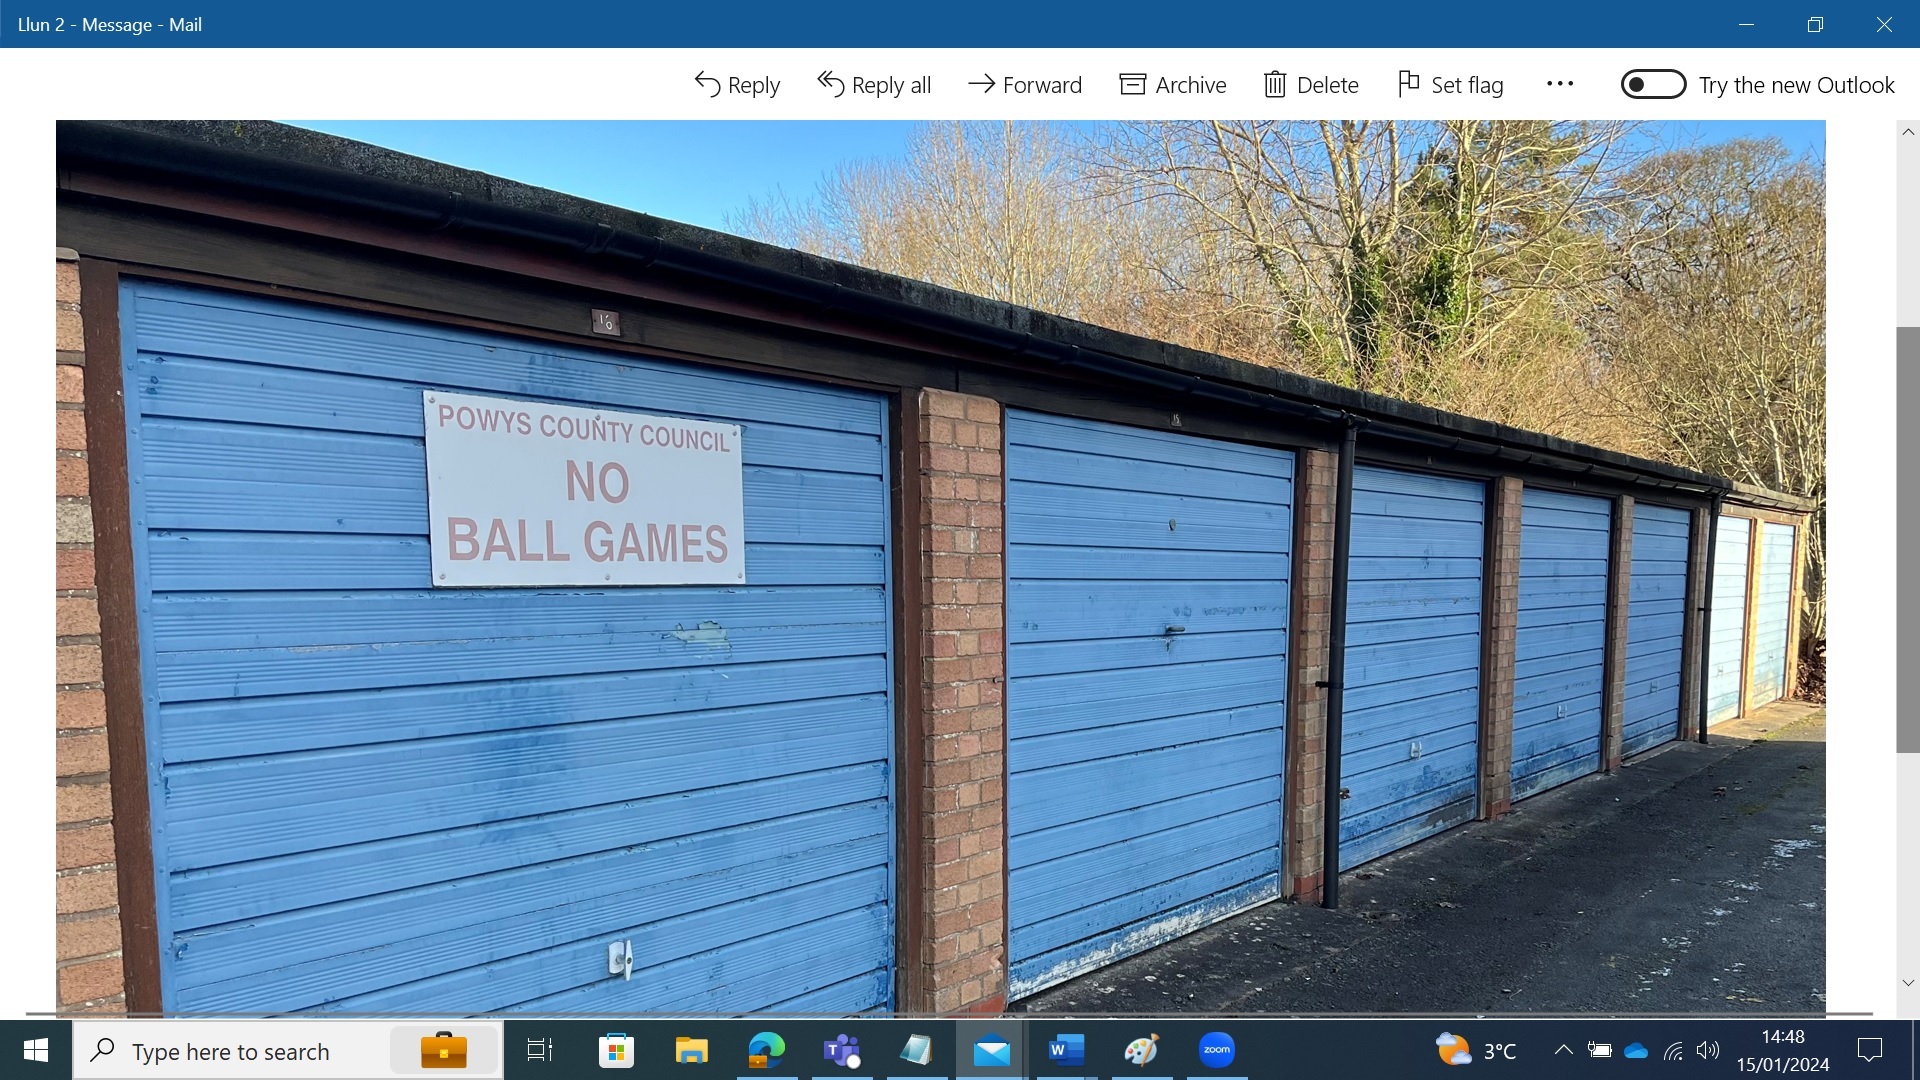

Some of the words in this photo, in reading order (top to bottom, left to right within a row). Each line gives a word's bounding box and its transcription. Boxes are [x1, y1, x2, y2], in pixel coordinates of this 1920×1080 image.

[18, 16, 50, 32] Llun
[55, 17, 65, 32] 2
[82, 17, 153, 36] Message
[169, 16, 202, 32] Mail
[729, 75, 782, 99] Reply
[853, 75, 906, 99] Reply
[910, 75, 931, 94] all
[1004, 75, 1082, 94] Forward
[1155, 75, 1227, 94] Archive
[1298, 75, 1360, 94] Delete
[1432, 76, 1463, 94] Set
[1467, 75, 1504, 99] flag
[1698, 76, 1729, 99] Try
[1733, 75, 1766, 94] the
[1772, 80, 1812, 94] new
[1817, 75, 1896, 94] Outlook
[438, 404, 532, 435] POWYS
[539, 414, 634, 443] COUNTY
[639, 424, 731, 453] COUNCIL
[566, 459, 629, 504] NO
[447, 517, 570, 562] BALL
[584, 520, 728, 563] GAMES
[1761, 1029, 1806, 1044] 14:48
[131, 1043, 180, 1066] Type
[187, 1042, 231, 1061] here
[236, 1044, 258, 1061] to
[264, 1042, 330, 1061] search
[1203, 1045, 1231, 1055] zoom
[1484, 1043, 1517, 1060] 3°C
[1737, 1057, 1831, 1074] 15/01/2024
